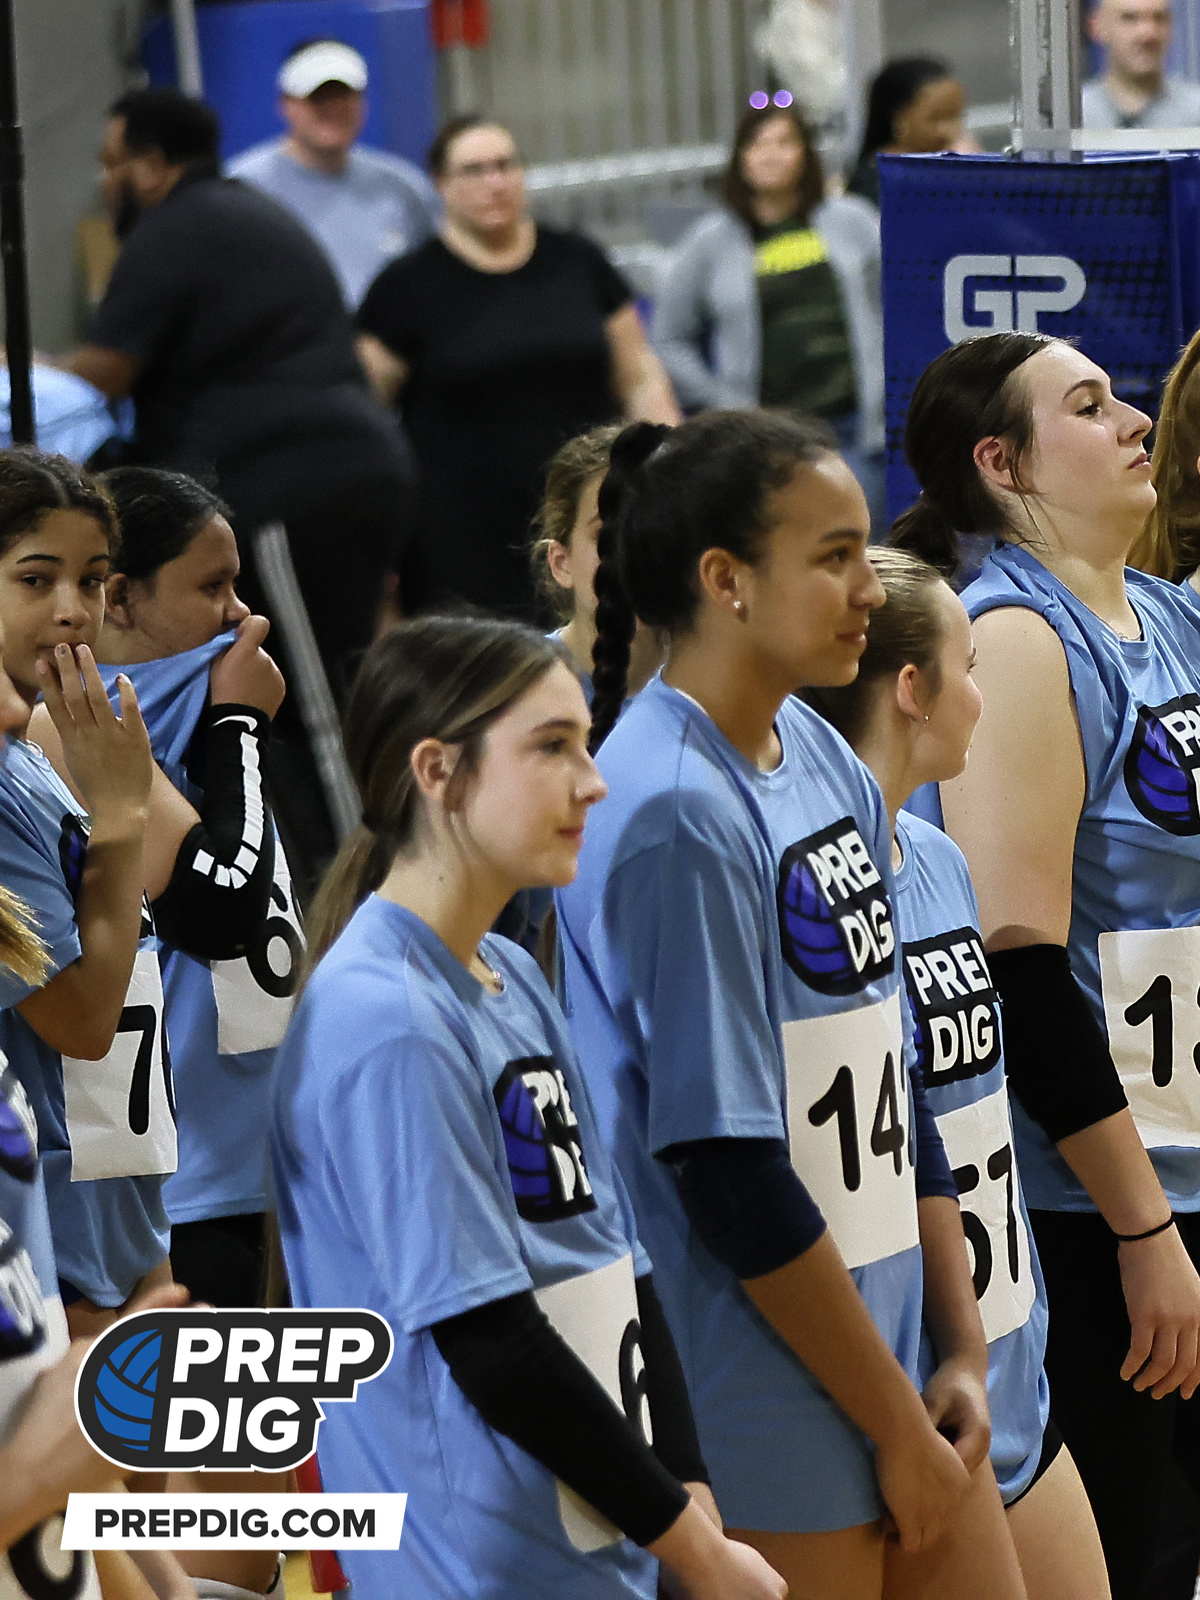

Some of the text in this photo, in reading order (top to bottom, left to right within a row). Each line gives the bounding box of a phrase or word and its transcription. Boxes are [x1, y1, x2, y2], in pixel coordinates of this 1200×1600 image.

[943, 254, 1087, 345] GP
[806, 830, 882, 907] PRE
[840, 900, 895, 974] DIG
[929, 1004, 994, 1073] DIG
[807, 1050, 916, 1193] 14
